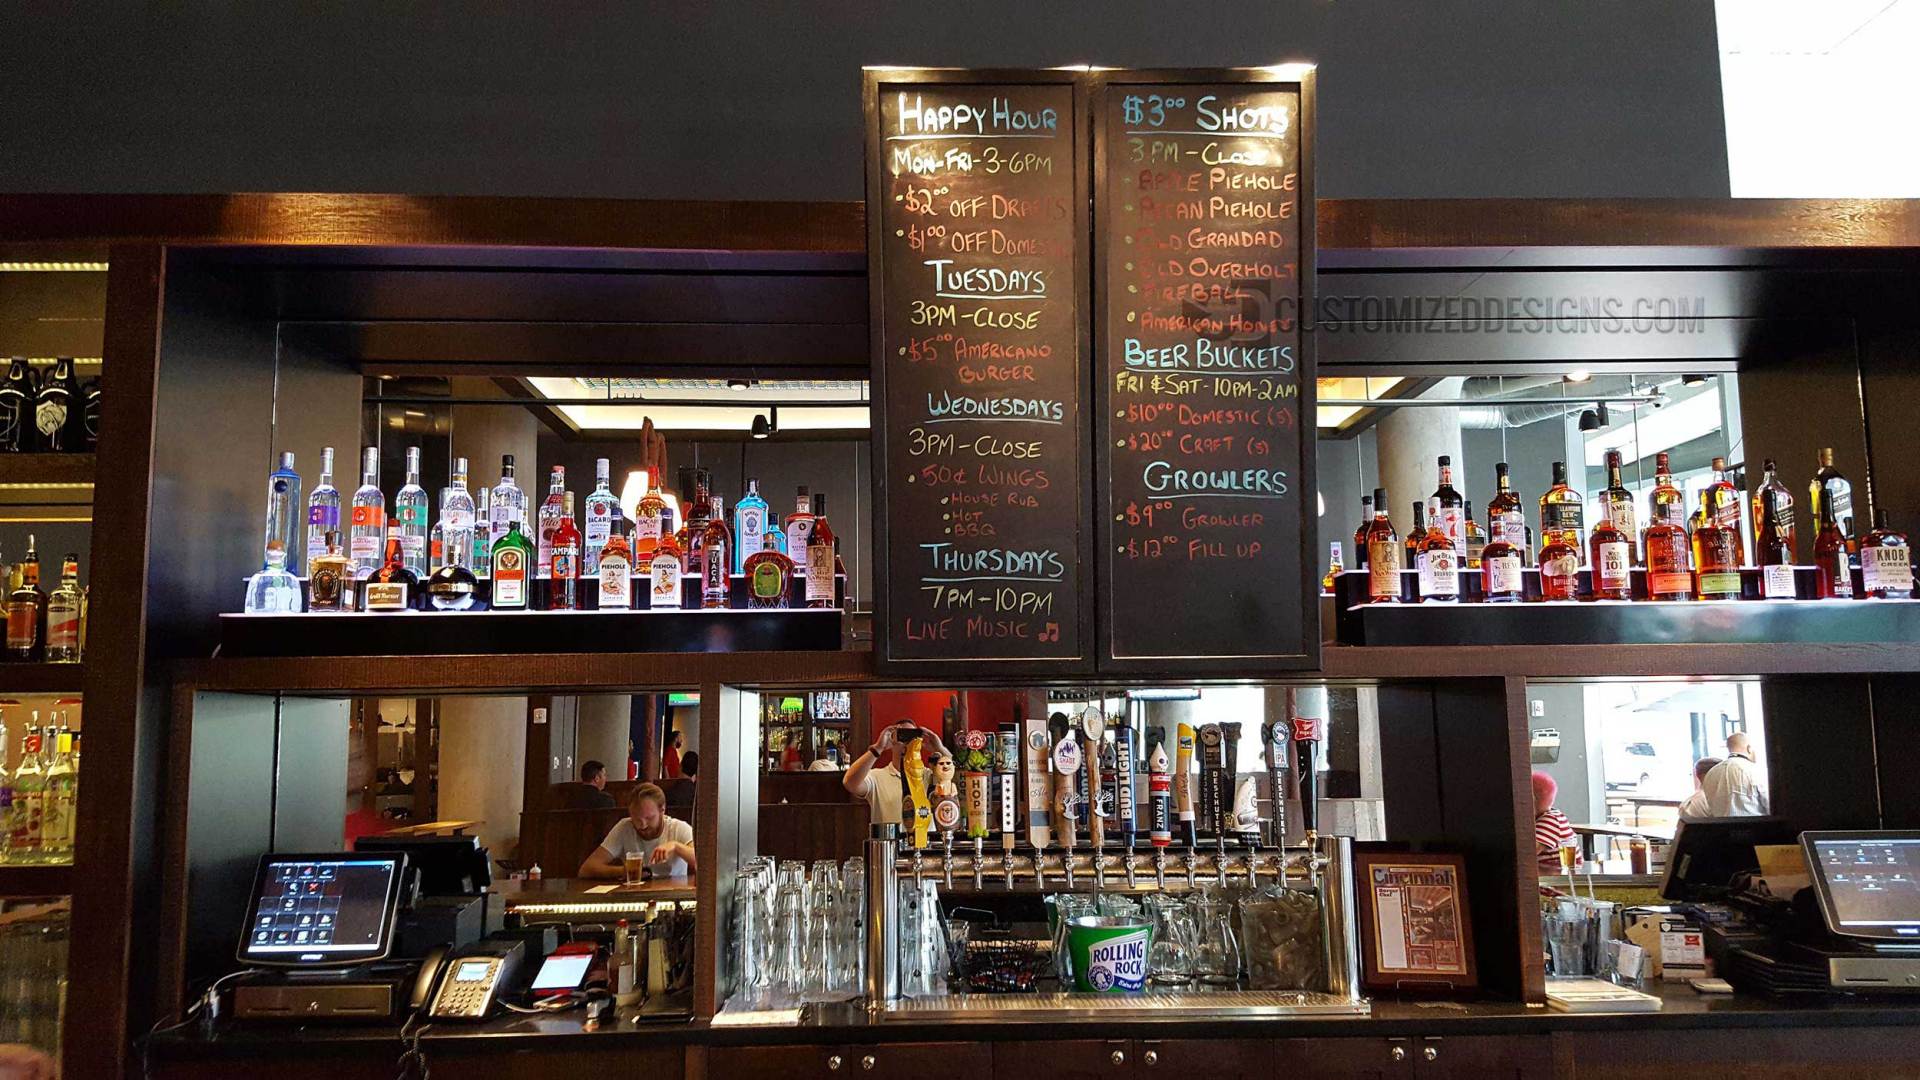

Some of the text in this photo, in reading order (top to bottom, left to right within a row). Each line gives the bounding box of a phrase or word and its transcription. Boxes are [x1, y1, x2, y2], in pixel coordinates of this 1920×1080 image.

[898, 93, 1057, 134] HAPPY HOUR
[1196, 96, 1289, 134] SHOTS
[1209, 168, 1297, 191] PIEHOLE
[949, 196, 989, 218] OFF
[1209, 196, 1292, 220] PIEHOLE
[951, 229, 989, 252] OFF
[1188, 226, 1284, 249] GRANDAD
[923, 260, 1046, 293] TUESDAYS
[1189, 257, 1297, 279] OVERHOLT
[1140, 312, 1294, 335] AMERICAN HONEY
[954, 337, 1052, 361] AMERICANO
[1124, 338, 1294, 372] BEER BUCKETS
[958, 365, 1035, 384] BURGER
[1116, 371, 1144, 393] FRI
[928, 390, 1064, 420] WEDNESDAYS
[1178, 404, 1260, 425] DOMESTIC
[1179, 434, 1234, 454] CRAFT
[978, 464, 1050, 489] WINGS
[1143, 461, 1288, 494] GROWLERS
[951, 492, 1039, 508] HOUSE RUB
[588, 516, 611, 524] BACARD
[951, 511, 984, 522] HOT
[1182, 507, 1264, 530] GROWLER
[954, 523, 997, 537] BBQ
[551, 546, 579, 556] CAMPARI
[920, 542, 1064, 578] THURSDAYS
[1188, 539, 1227, 560] FILL
[1237, 542, 1262, 559] UP
[1431, 554, 1440, 563] JIM
[1876, 549, 1905, 561] KNOB
[1606, 561, 1623, 570] 101
[906, 616, 1029, 640] LIVE MUSIC
[1117, 741, 1132, 819] BUD LIGHT
[972, 779, 981, 809] HOP
[1212, 771, 1220, 834] DESCHUTES
[1276, 771, 1286, 834] DESCHUTES
[1156, 799, 1164, 829] FRANZ
[1093, 940, 1143, 962] ROLLING
[1115, 960, 1142, 976] ROCK
